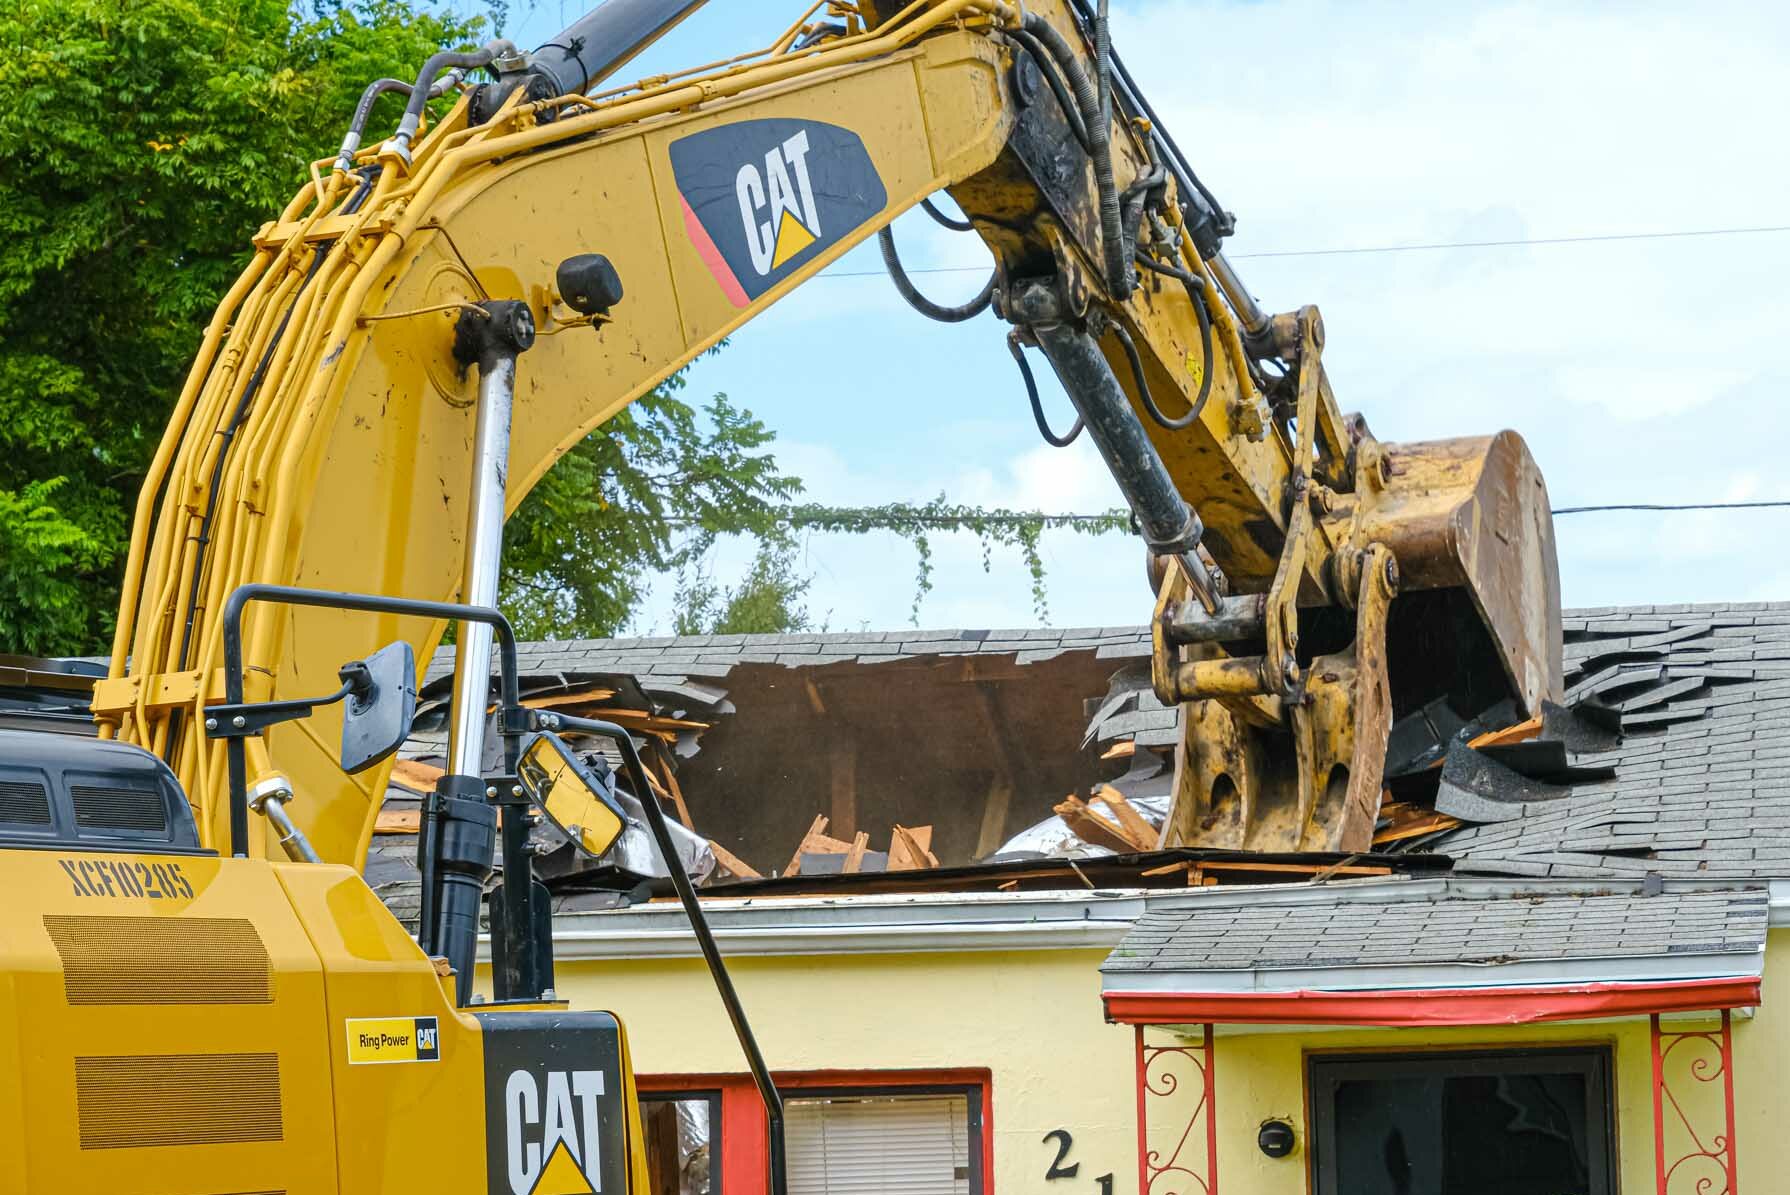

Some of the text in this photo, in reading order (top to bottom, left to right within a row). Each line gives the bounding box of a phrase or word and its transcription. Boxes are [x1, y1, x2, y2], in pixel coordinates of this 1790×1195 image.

[735, 129, 822, 276] CAT
[58, 859, 194, 899] XCF10285
[359, 1033, 409, 1050] Ring Power
[416, 1028, 436, 1050] CAT
[505, 1069, 605, 1195] CAT
